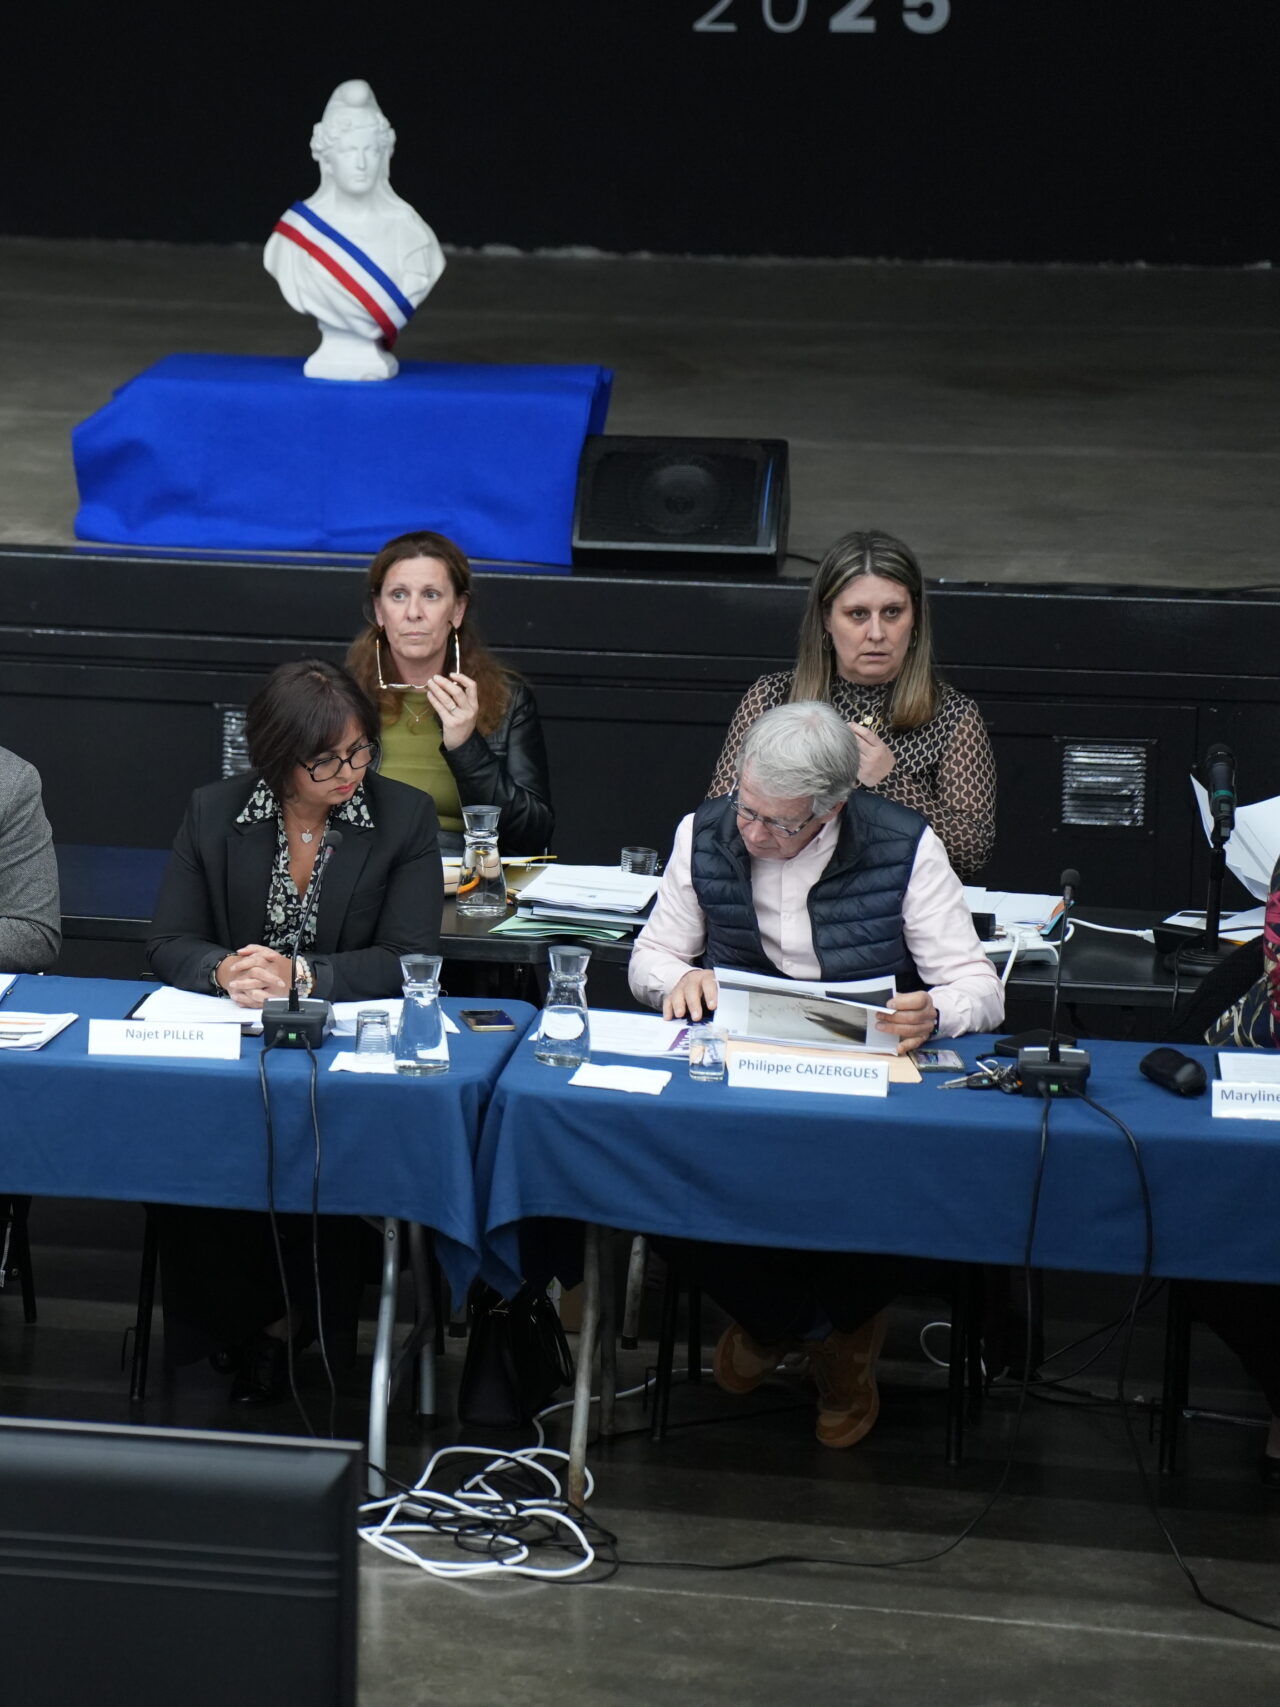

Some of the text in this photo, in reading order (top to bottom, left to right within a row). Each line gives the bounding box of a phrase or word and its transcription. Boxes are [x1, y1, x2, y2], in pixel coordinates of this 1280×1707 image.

[692, 0, 951, 33] 2025
[125, 1028, 205, 1042] Najet PILLER
[738, 1059, 880, 1079] Philippe CAIZERGUES
